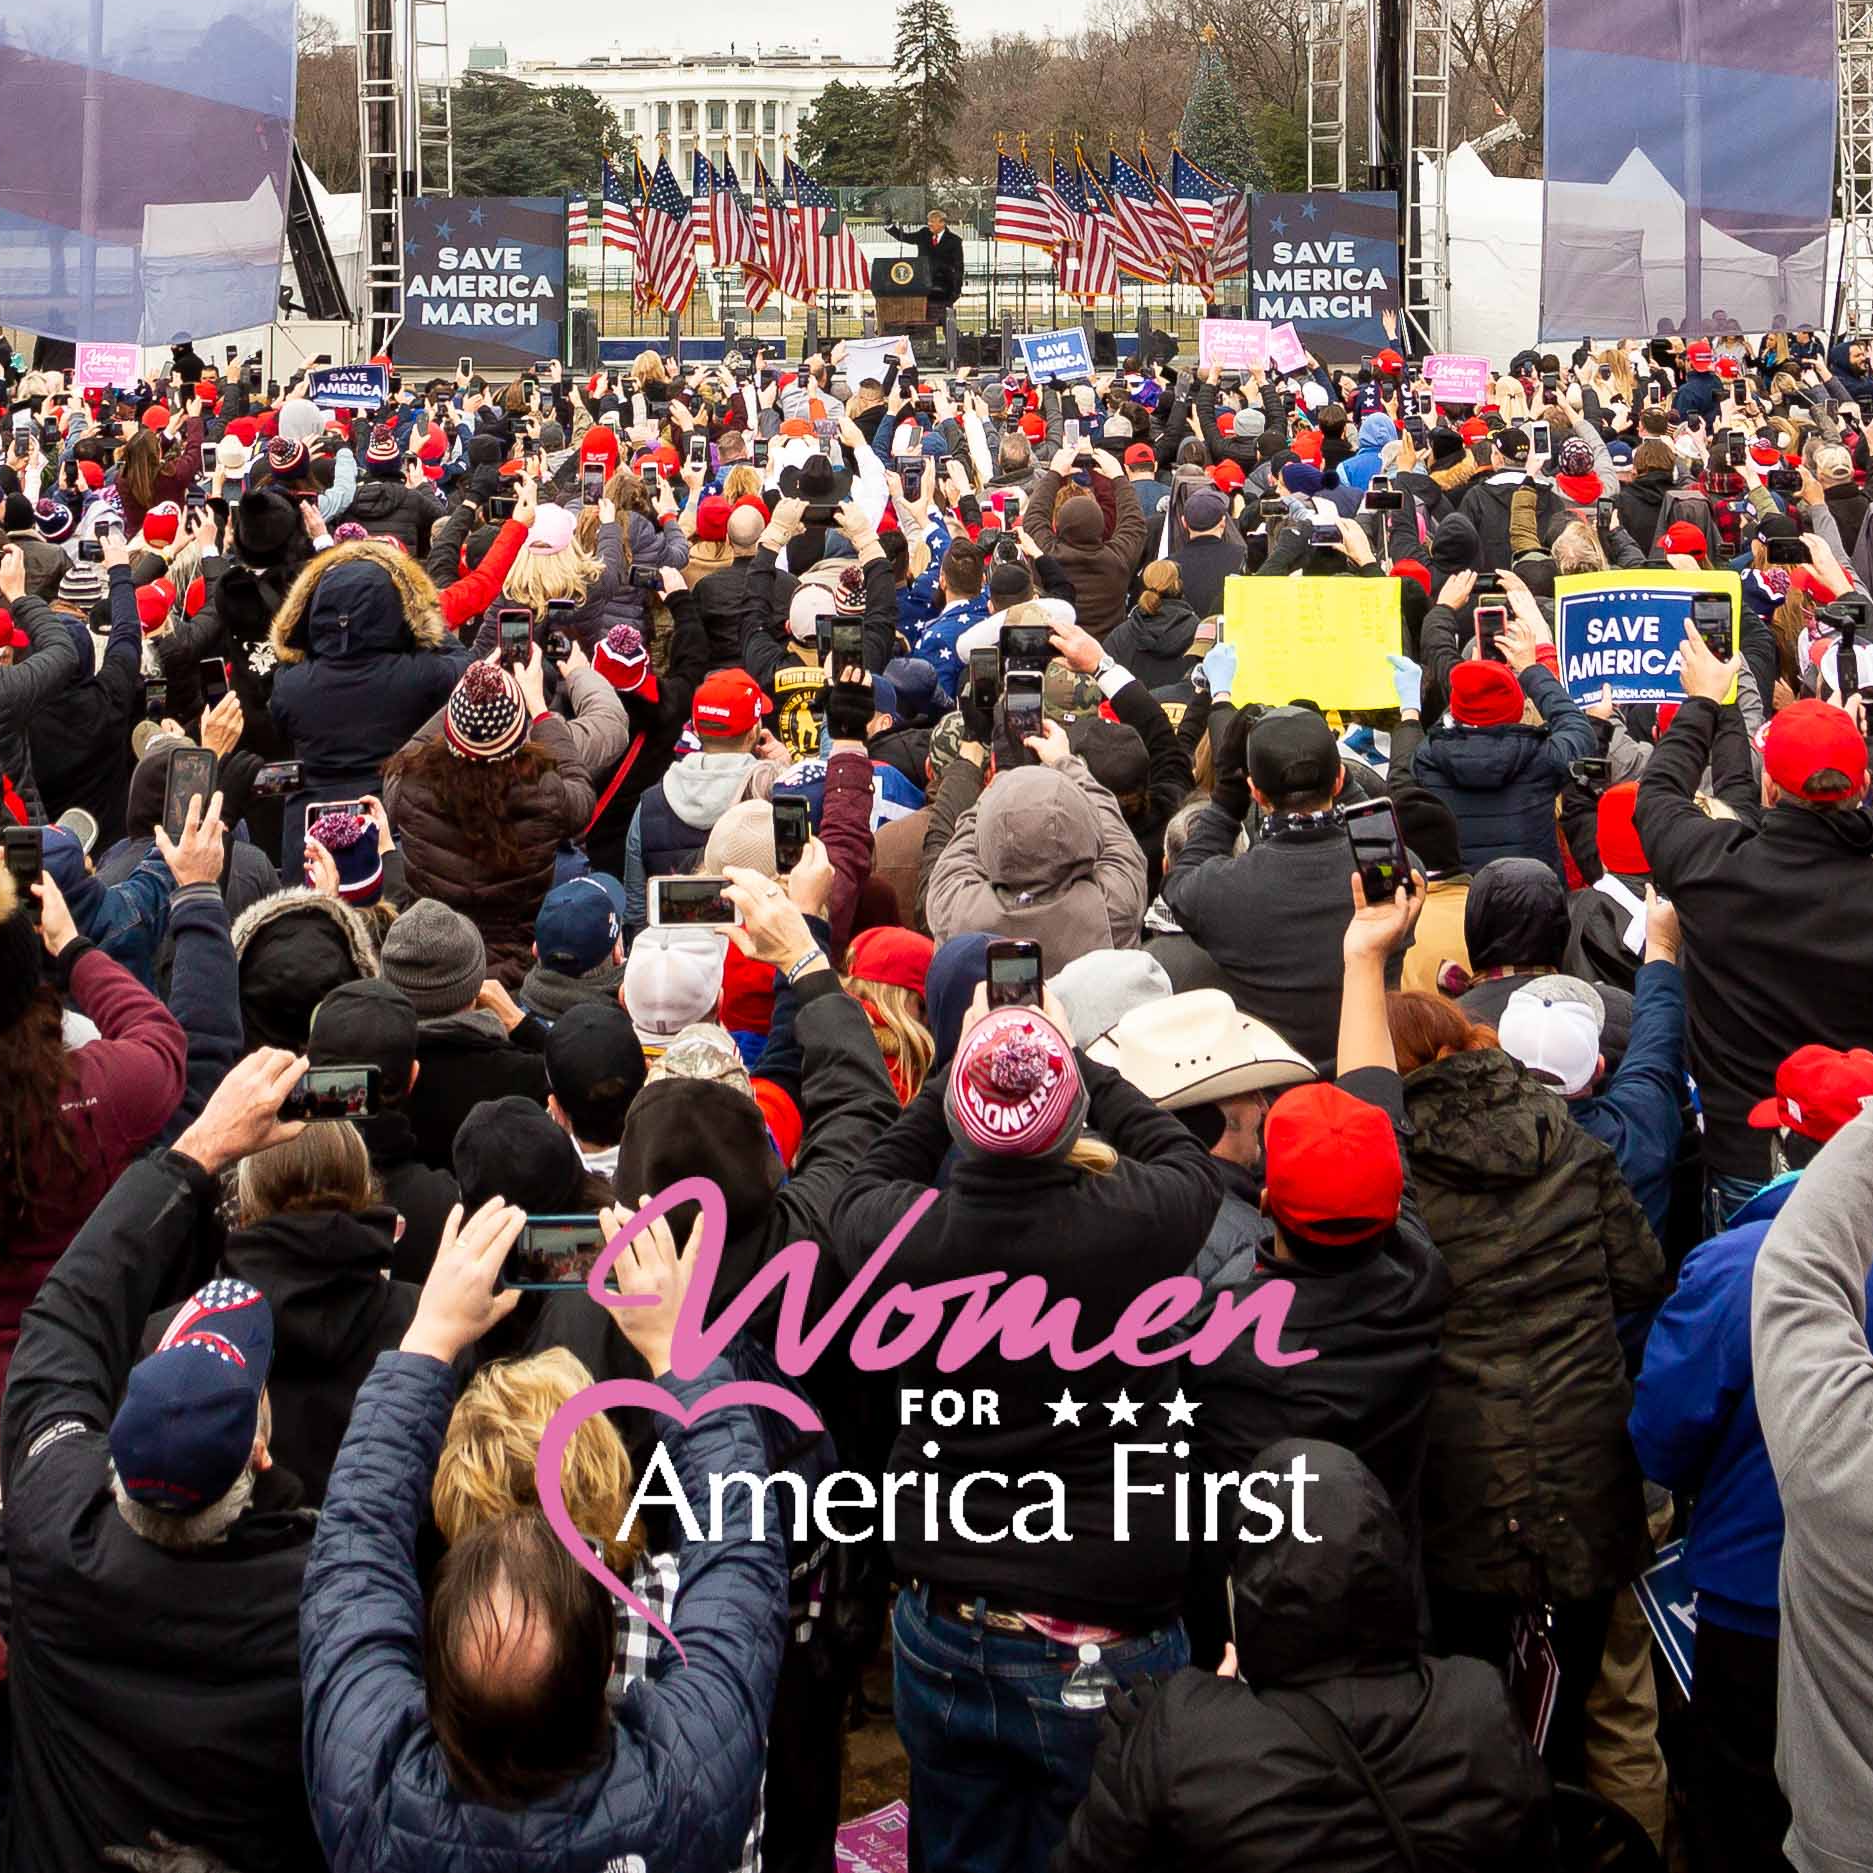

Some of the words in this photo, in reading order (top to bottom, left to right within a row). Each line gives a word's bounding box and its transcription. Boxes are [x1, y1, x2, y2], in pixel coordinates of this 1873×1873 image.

[438, 247, 522, 270] SAVE
[1274, 242, 1354, 264] SAVE
[407, 275, 554, 298] AMERICA
[421, 303, 538, 326] MARCH
[1259, 296, 1372, 319] MARCH
[1036, 342, 1070, 359] SAVE
[329, 372, 368, 382] SAVE
[317, 382, 382, 397] AMERICA
[1586, 616, 1660, 643] SAVE
[1568, 649, 1682, 682] AMERICA
